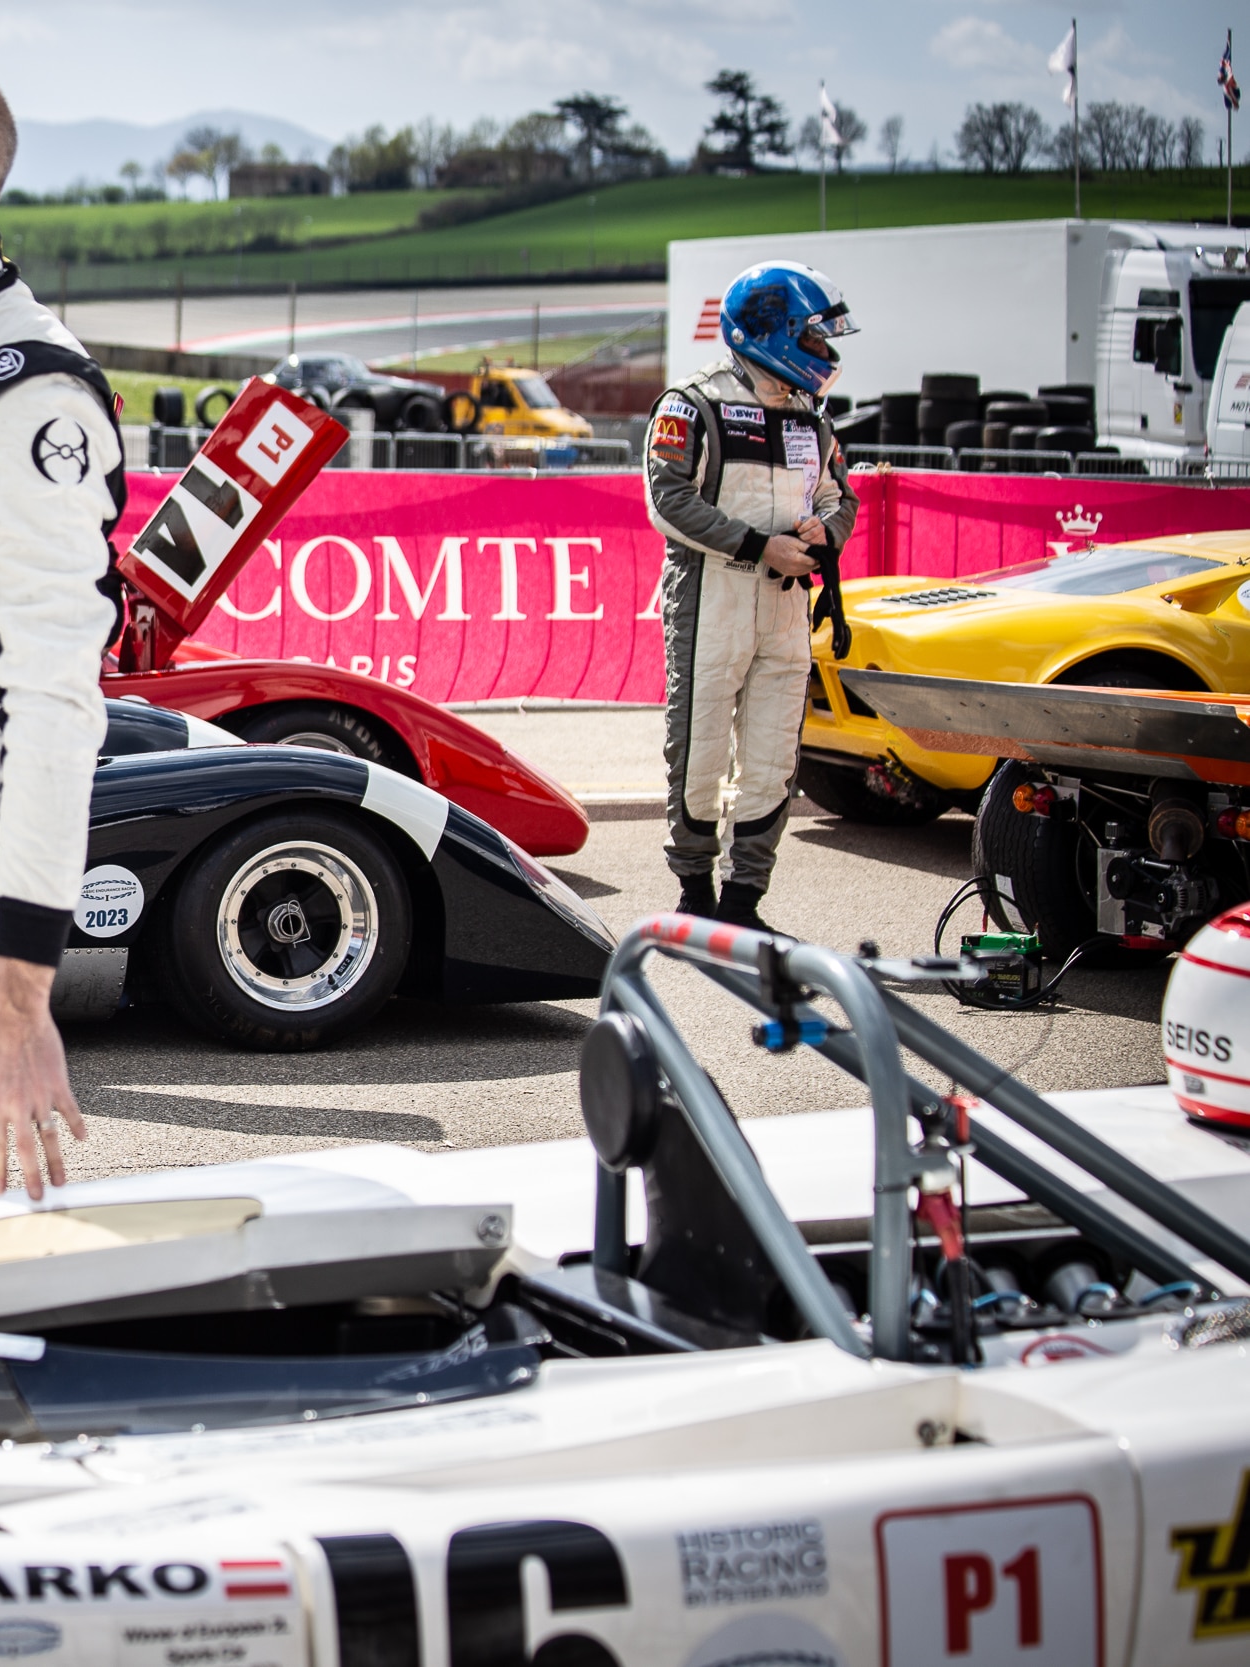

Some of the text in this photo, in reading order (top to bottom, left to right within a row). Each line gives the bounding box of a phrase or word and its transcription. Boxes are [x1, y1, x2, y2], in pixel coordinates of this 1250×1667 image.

[735, 408, 759, 418] BWT
[256, 423, 295, 464] P1
[133, 465, 247, 586] 14
[291, 654, 418, 687] RIS
[327, 709, 383, 760] AVON
[85, 908, 129, 929] 2023
[676, 1519, 824, 1552] HISTORIC
[681, 1543, 827, 1585] RACING
[943, 1545, 1043, 1657] P1
